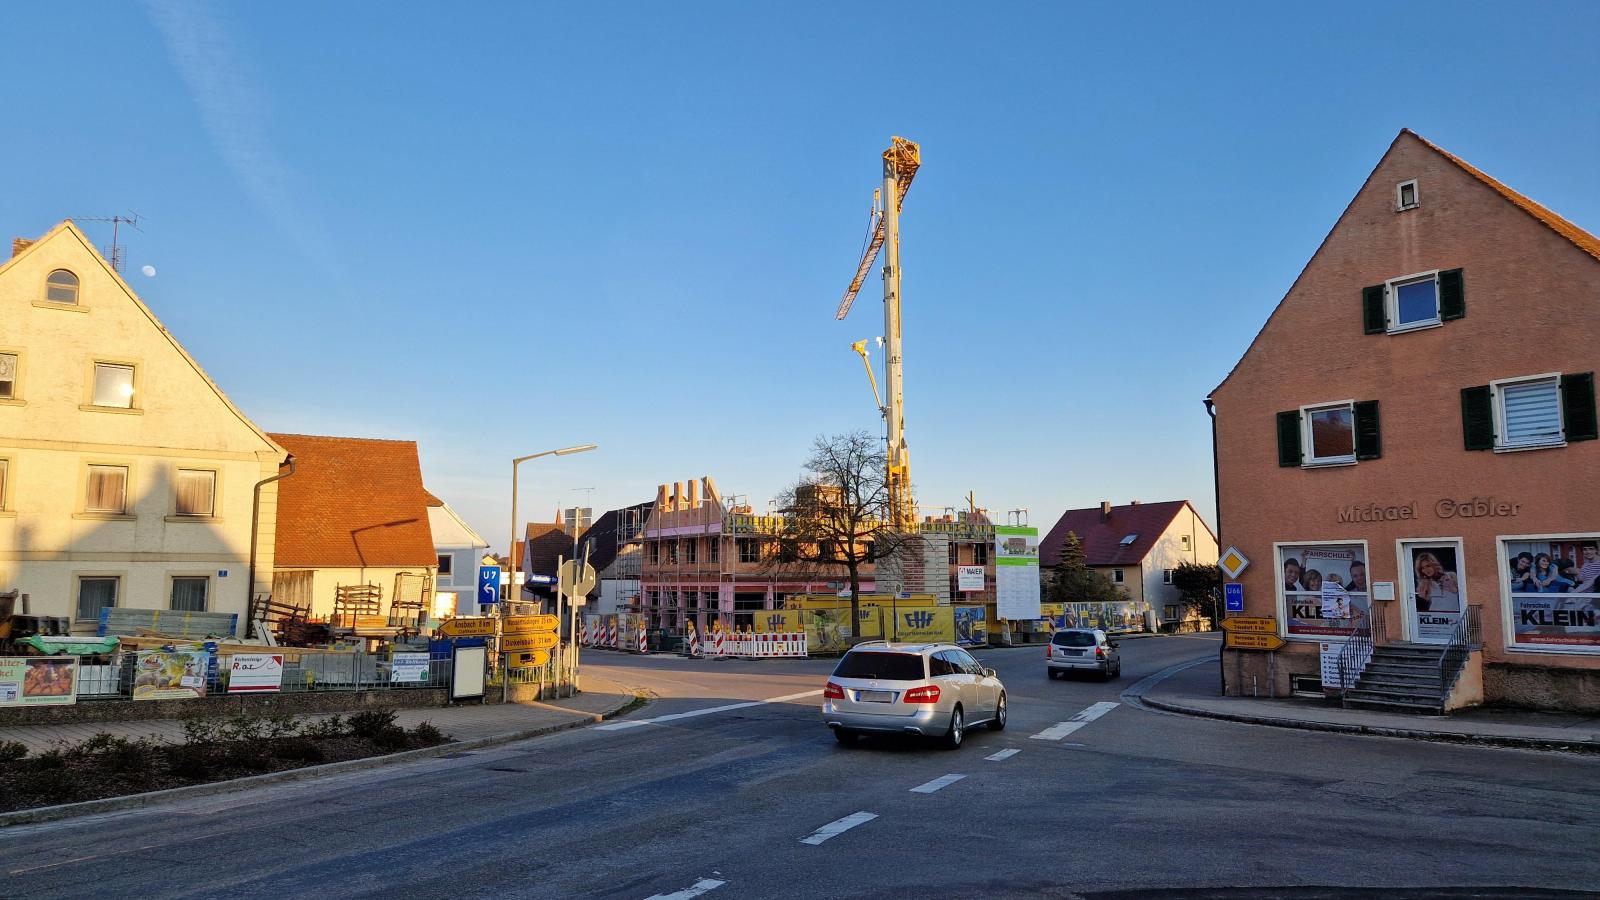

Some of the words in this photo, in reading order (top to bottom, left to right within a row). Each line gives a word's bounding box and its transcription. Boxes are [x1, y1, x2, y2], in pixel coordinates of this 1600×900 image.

[1337, 501, 1418, 523] Michael
[1435, 497, 1524, 519] Gabler
[1306, 549, 1352, 559] FAHRSCHULE
[483, 571, 490, 580] U
[491, 571, 497, 580] 7
[1419, 617, 1449, 625] KLEIN
[1520, 609, 1595, 627] KLEIN
[454, 620, 476, 629] Ansbach
